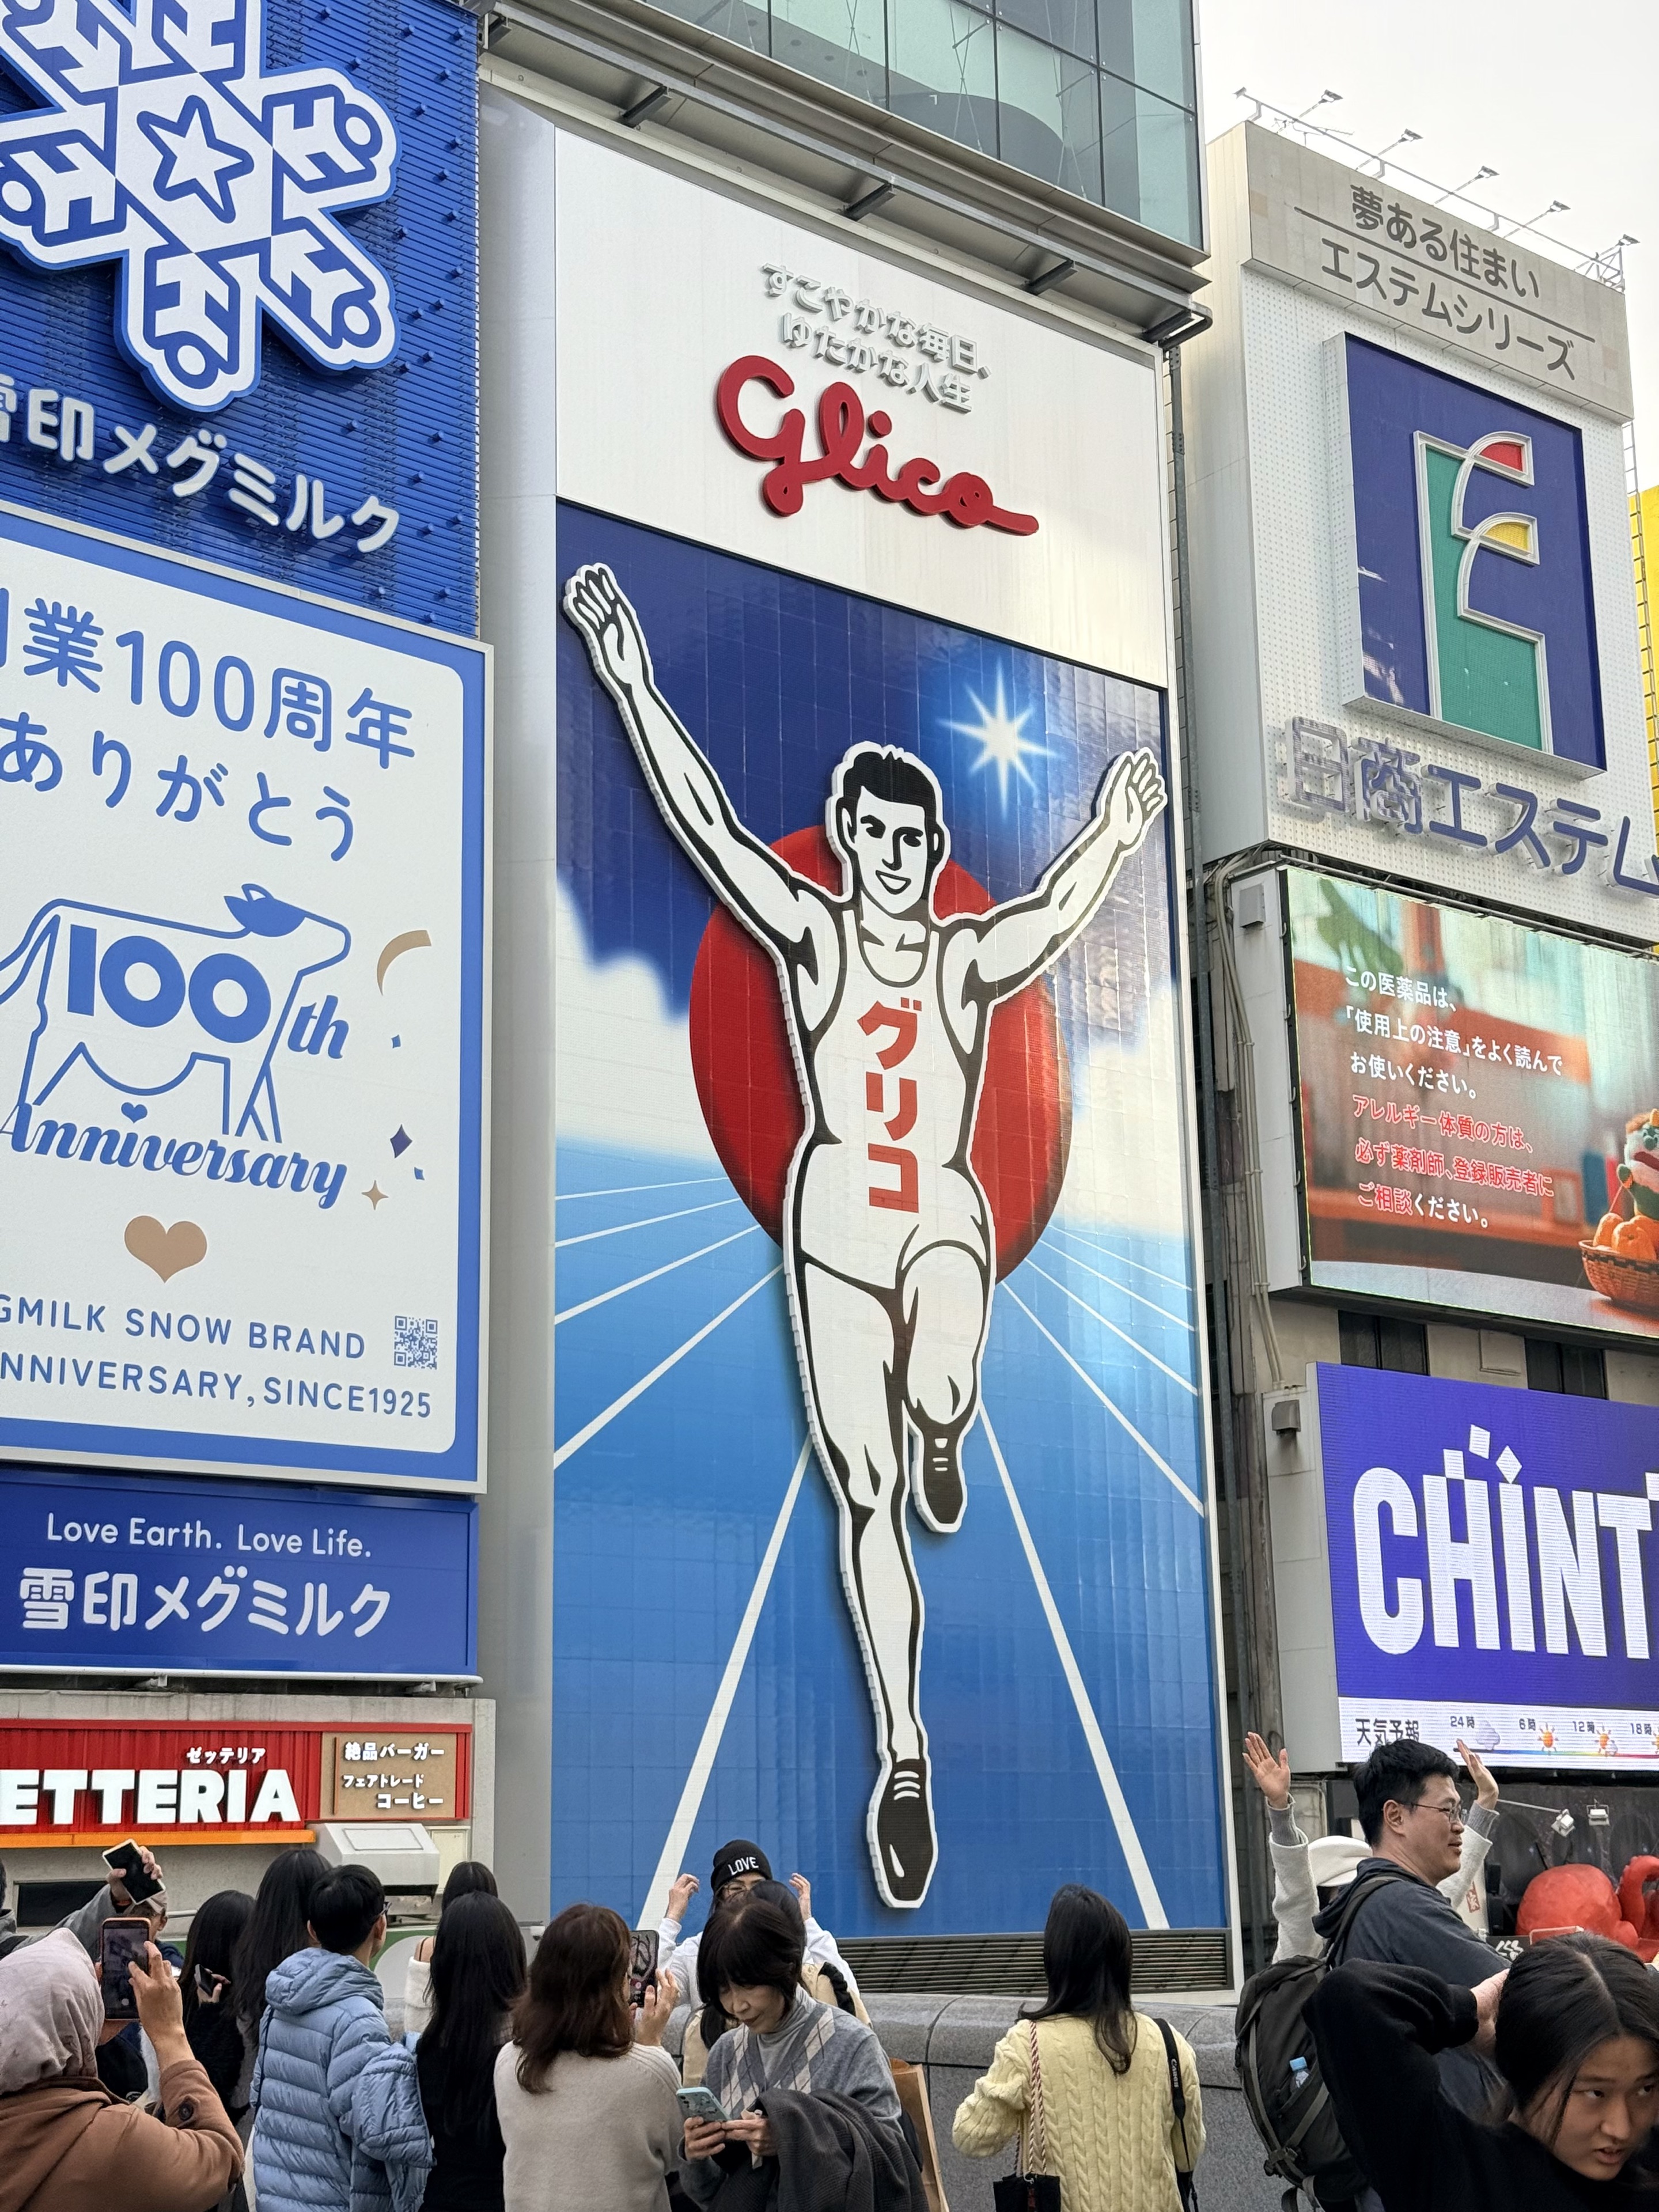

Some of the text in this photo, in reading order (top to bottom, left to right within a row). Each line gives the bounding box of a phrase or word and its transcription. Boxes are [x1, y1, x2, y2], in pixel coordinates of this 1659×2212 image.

[1350, 184, 1539, 299] 夢ある住まい
[761, 263, 991, 379] すこやかな毎日、
[1321, 237, 1575, 381] エステムシリーズ
[780, 312, 972, 414] ゆたかな人生
[717, 354, 1039, 536] Glico
[0, 588, 415, 770] 業100周年
[0, 711, 354, 862] ありがとう
[1345, 966, 1457, 1012] この医薬品は、
[1346, 1005, 1563, 1077] 「使用上の注意」をよく読んで
[857, 997, 922, 1214] グリコ
[1350, 1052, 1476, 1099] お使いください。
[1351, 1094, 1533, 1154] アレルギー体質の方は、
[0, 1101, 348, 1209] Anniversary
[1355, 1137, 1555, 1198] 必ず薬剤師、登録販売者に
[1358, 1182, 1488, 1228] ご相談ください。
[126, 1308, 232, 1345] SNOW
[248, 1321, 365, 1359] BRAND
[47, 1512, 372, 1558] Love Earth. Love Life.
[20, 1565, 391, 1638] 雪印メグミルク
[186, 1747, 266, 1764] ゼッテリア
[345, 1741, 445, 1761] 絶品バーガー
[1355, 1718, 1420, 1745] 天気予報
[0, 1769, 302, 1825] ETTERIA
[343, 1774, 425, 1789] フェアトレード
[377, 1791, 444, 1810] コーヒー
[728, 1856, 759, 1876] LOVE
